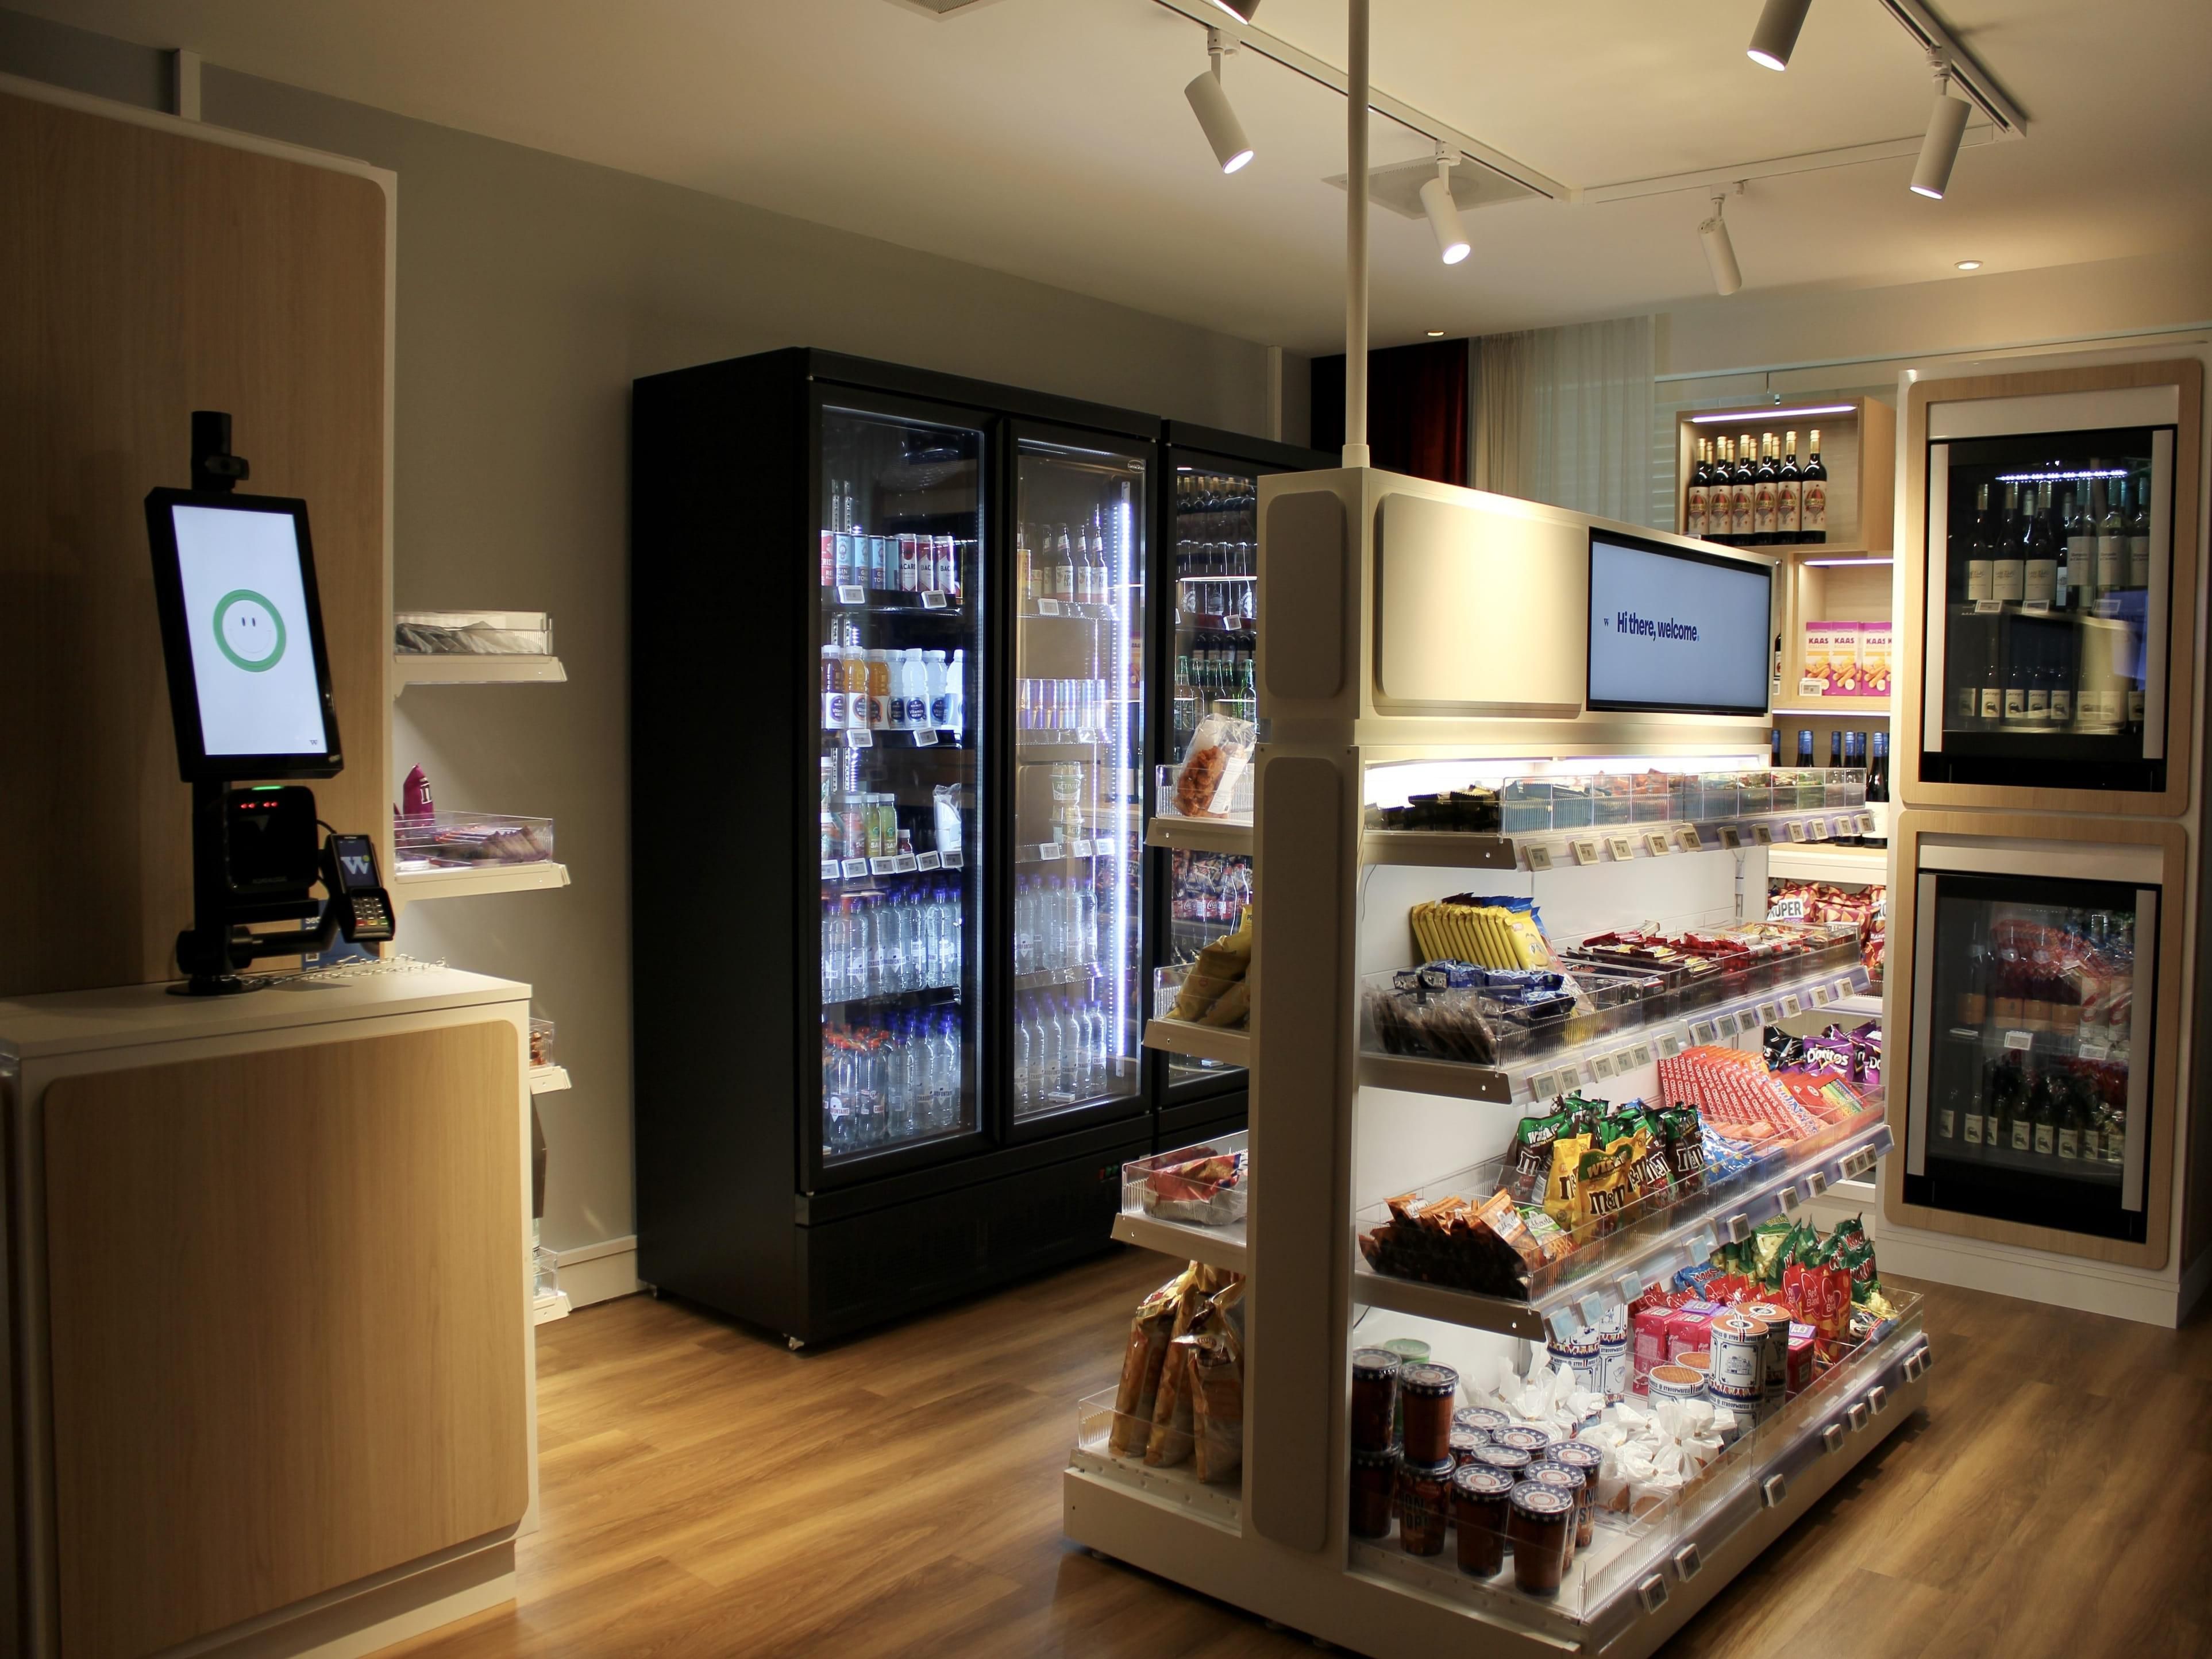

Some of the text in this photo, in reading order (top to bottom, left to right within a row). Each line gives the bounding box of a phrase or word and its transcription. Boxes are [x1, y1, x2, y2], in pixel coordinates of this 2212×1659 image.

[1604, 618, 1609, 627] W
[1617, 611, 1700, 642] Hi there, welcome.
[340, 856, 369, 874] W
[1807, 1048, 1849, 1066] Doritos
[1808, 1287, 1817, 1298] Red
[1806, 1296, 1820, 1307] Band
[1663, 1386, 1690, 1394] STROOPWAFELS
